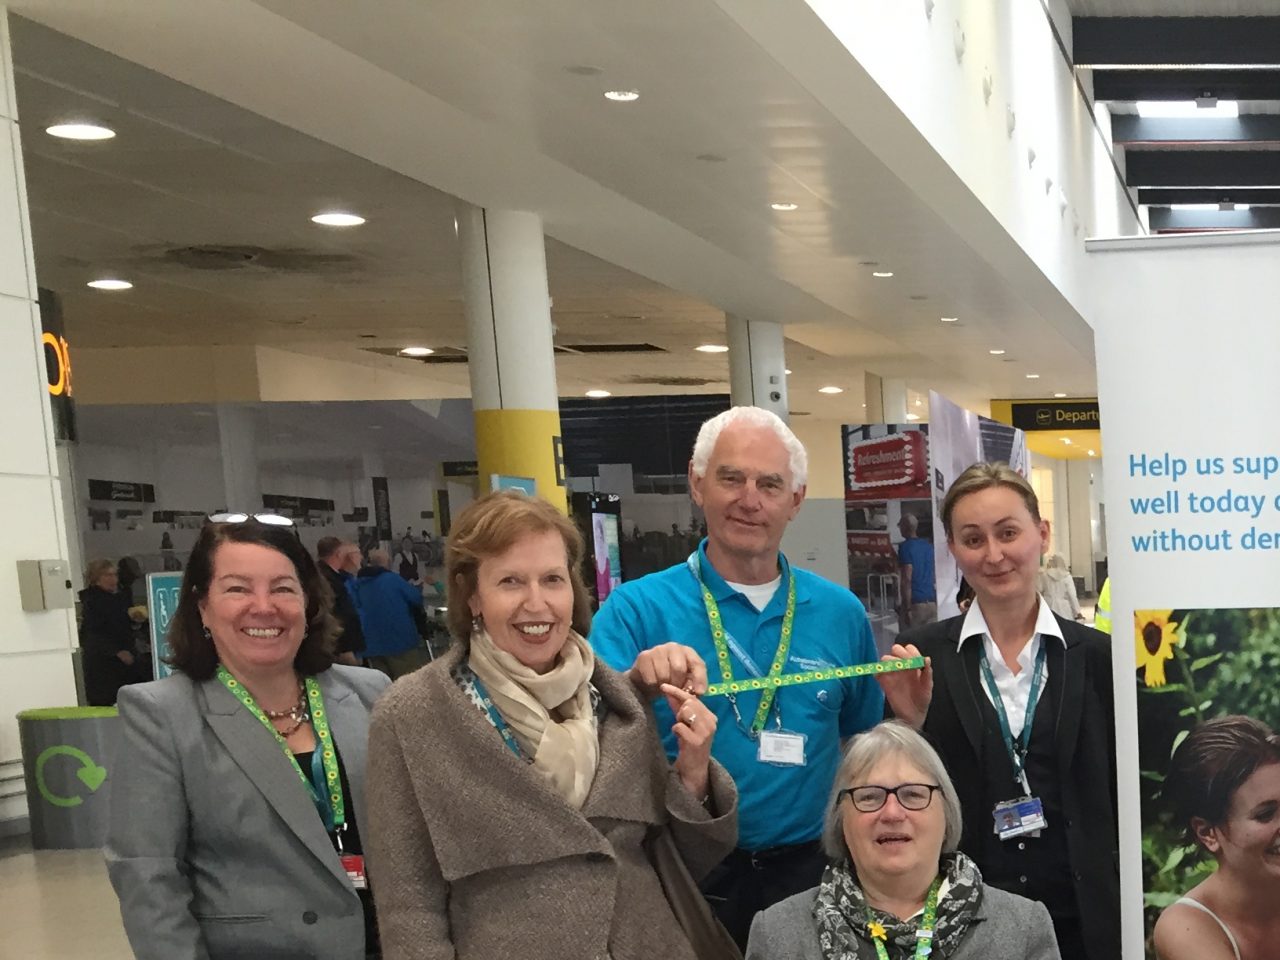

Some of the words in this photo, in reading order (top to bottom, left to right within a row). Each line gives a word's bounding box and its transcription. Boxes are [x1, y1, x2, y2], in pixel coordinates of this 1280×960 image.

[1130, 452, 1187, 481] Help
[1196, 455, 1224, 475] us
[1130, 493, 1179, 515] well
[1188, 490, 1266, 518] today
[1131, 528, 1231, 552] without
